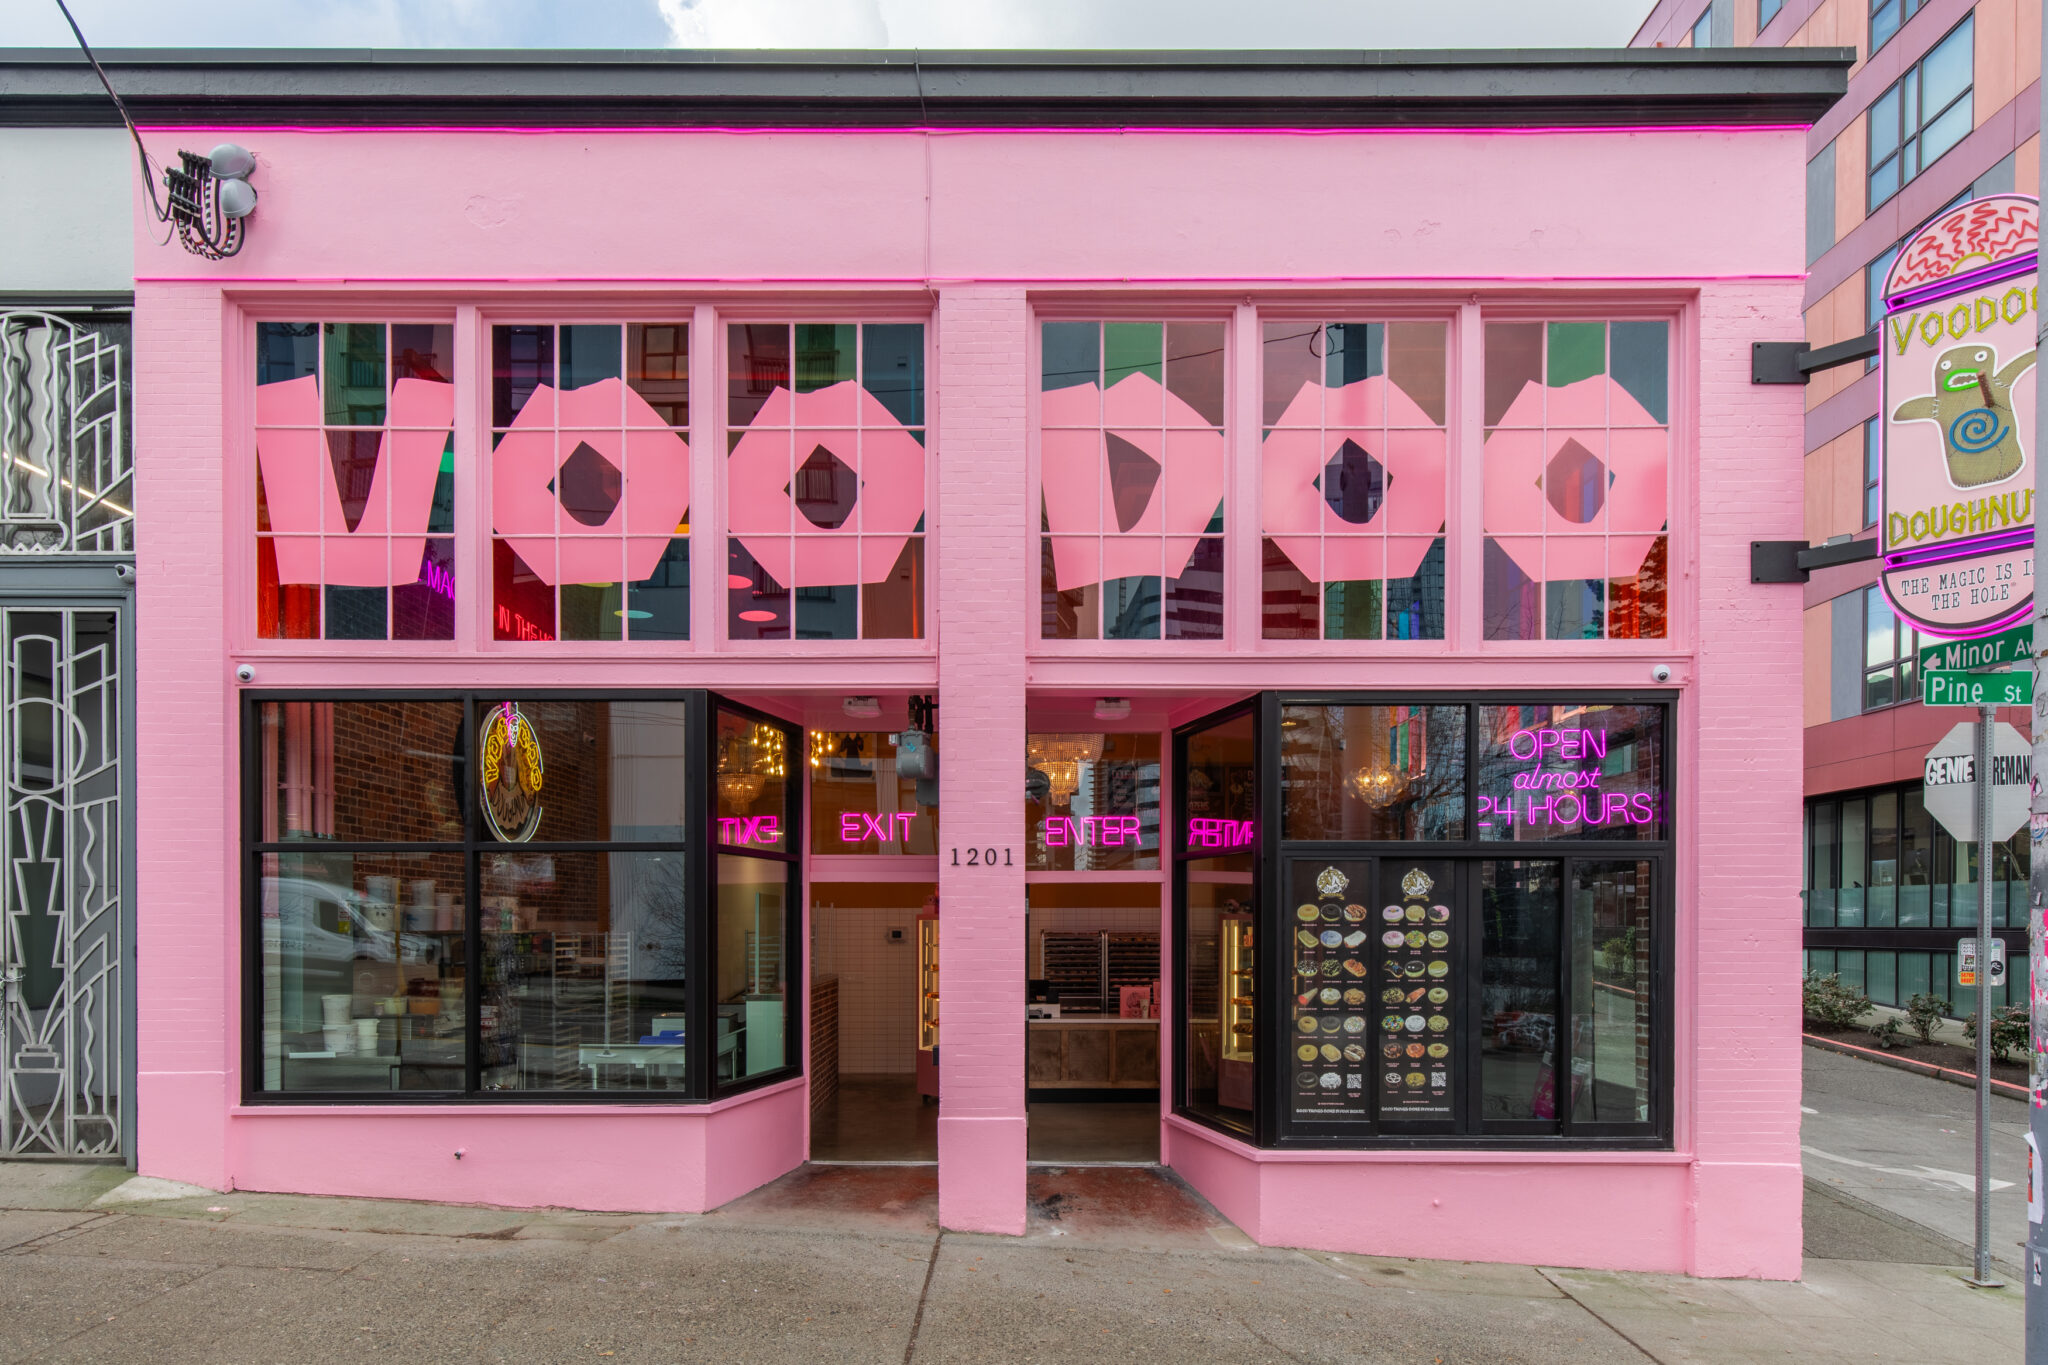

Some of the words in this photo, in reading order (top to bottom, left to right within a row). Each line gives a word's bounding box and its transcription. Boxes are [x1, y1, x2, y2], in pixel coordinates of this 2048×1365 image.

[1890, 285, 2038, 356] VOODO
[1888, 488, 2035, 548] DOUGHNU
[427, 560, 455, 600] MA
[1901, 577, 1929, 597] THE
[1939, 567, 1985, 590] MAGIC
[1995, 563, 2012, 581] IS
[2023, 559, 2034, 577] I
[1931, 592, 1960, 611] THE
[1970, 584, 2009, 605] HOLE
[1946, 640, 2005, 671] Minor
[1931, 676, 1983, 702] Pine
[2004, 685, 2022, 702] St
[1510, 729, 1606, 760] OPEN
[1513, 763, 1602, 789] almost
[1925, 755, 1974, 785] GENIE
[1992, 755, 2032, 786] REMAN
[1477, 796, 1517, 827] 24
[1528, 792, 1653, 825] HOURS
[841, 813, 917, 842] EXIT
[1045, 816, 1142, 846] ENTER
[951, 847, 1013, 866] 1201
